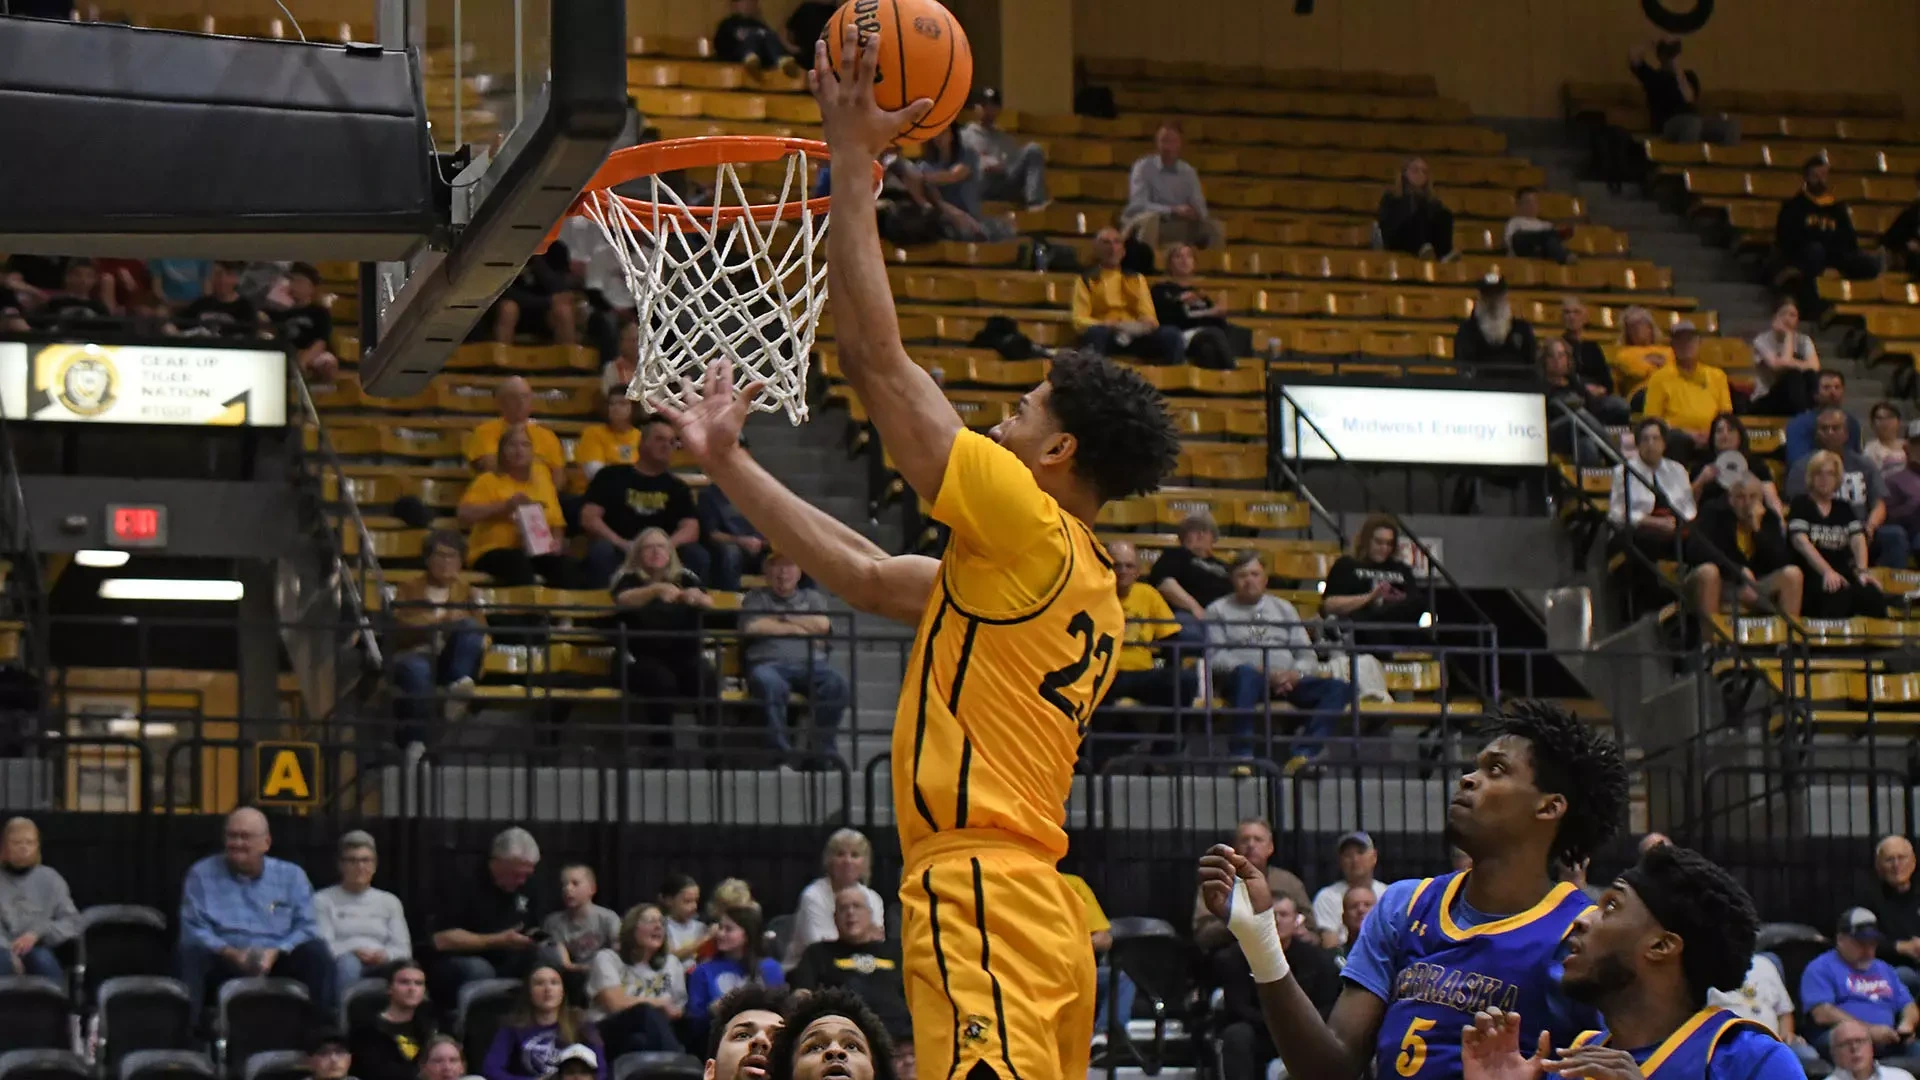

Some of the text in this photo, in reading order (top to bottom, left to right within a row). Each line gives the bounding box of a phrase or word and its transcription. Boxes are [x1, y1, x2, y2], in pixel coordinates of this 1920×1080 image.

[141, 356, 219, 369] GEAR UP
[142, 370, 192, 382] TIGER
[141, 386, 210, 398] NATION
[1342, 416, 1424, 434] Midwest
[1508, 422, 1543, 440] Inc.
[1038, 609, 1115, 738] 23
[263, 750, 309, 797] A
[1392, 961, 1518, 1016] EBRASKA
[1396, 1016, 1437, 1077] 5
